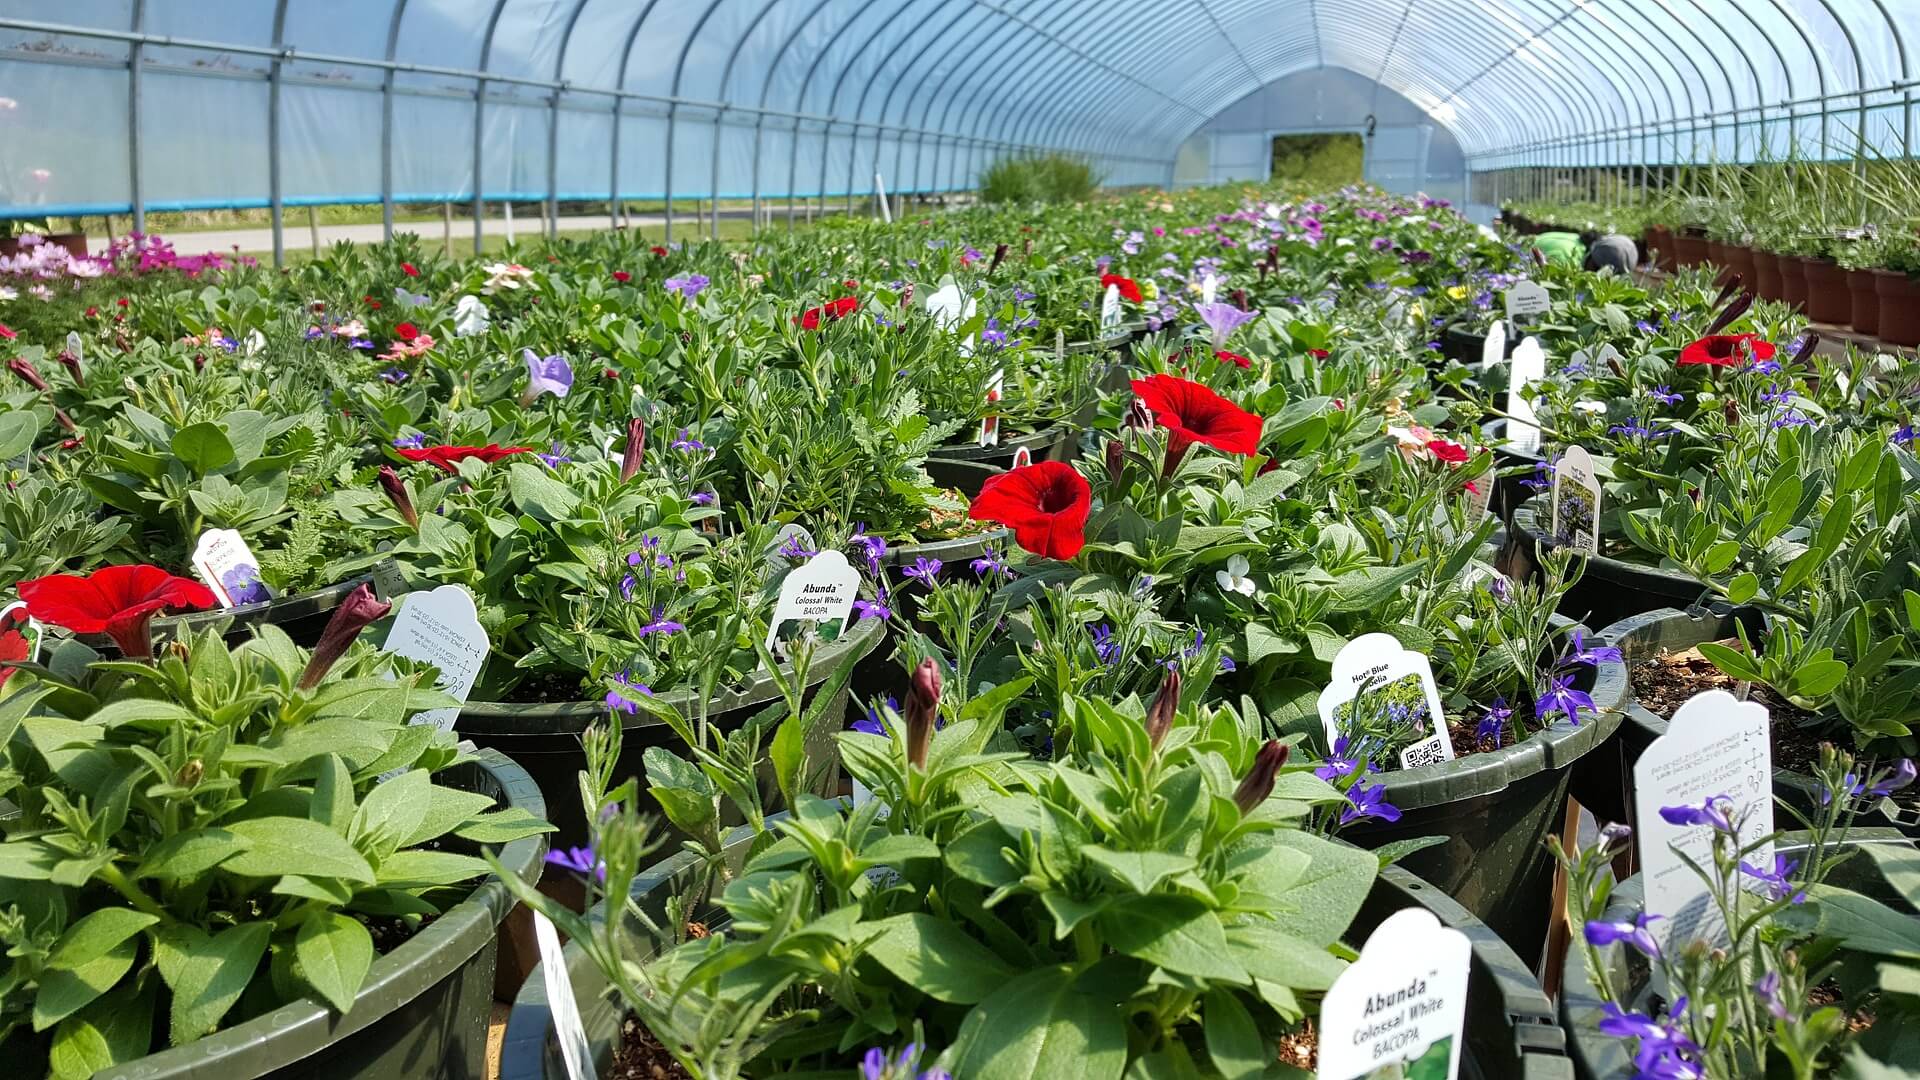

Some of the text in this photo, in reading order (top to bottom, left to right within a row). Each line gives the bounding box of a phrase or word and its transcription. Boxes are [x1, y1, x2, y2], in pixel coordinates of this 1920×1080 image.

[795, 596, 843, 605] Colossal White
[803, 606, 828, 615] BACOPA
[1371, 663, 1388, 675] Blue
[1353, 998, 1443, 1045] Colossal White
